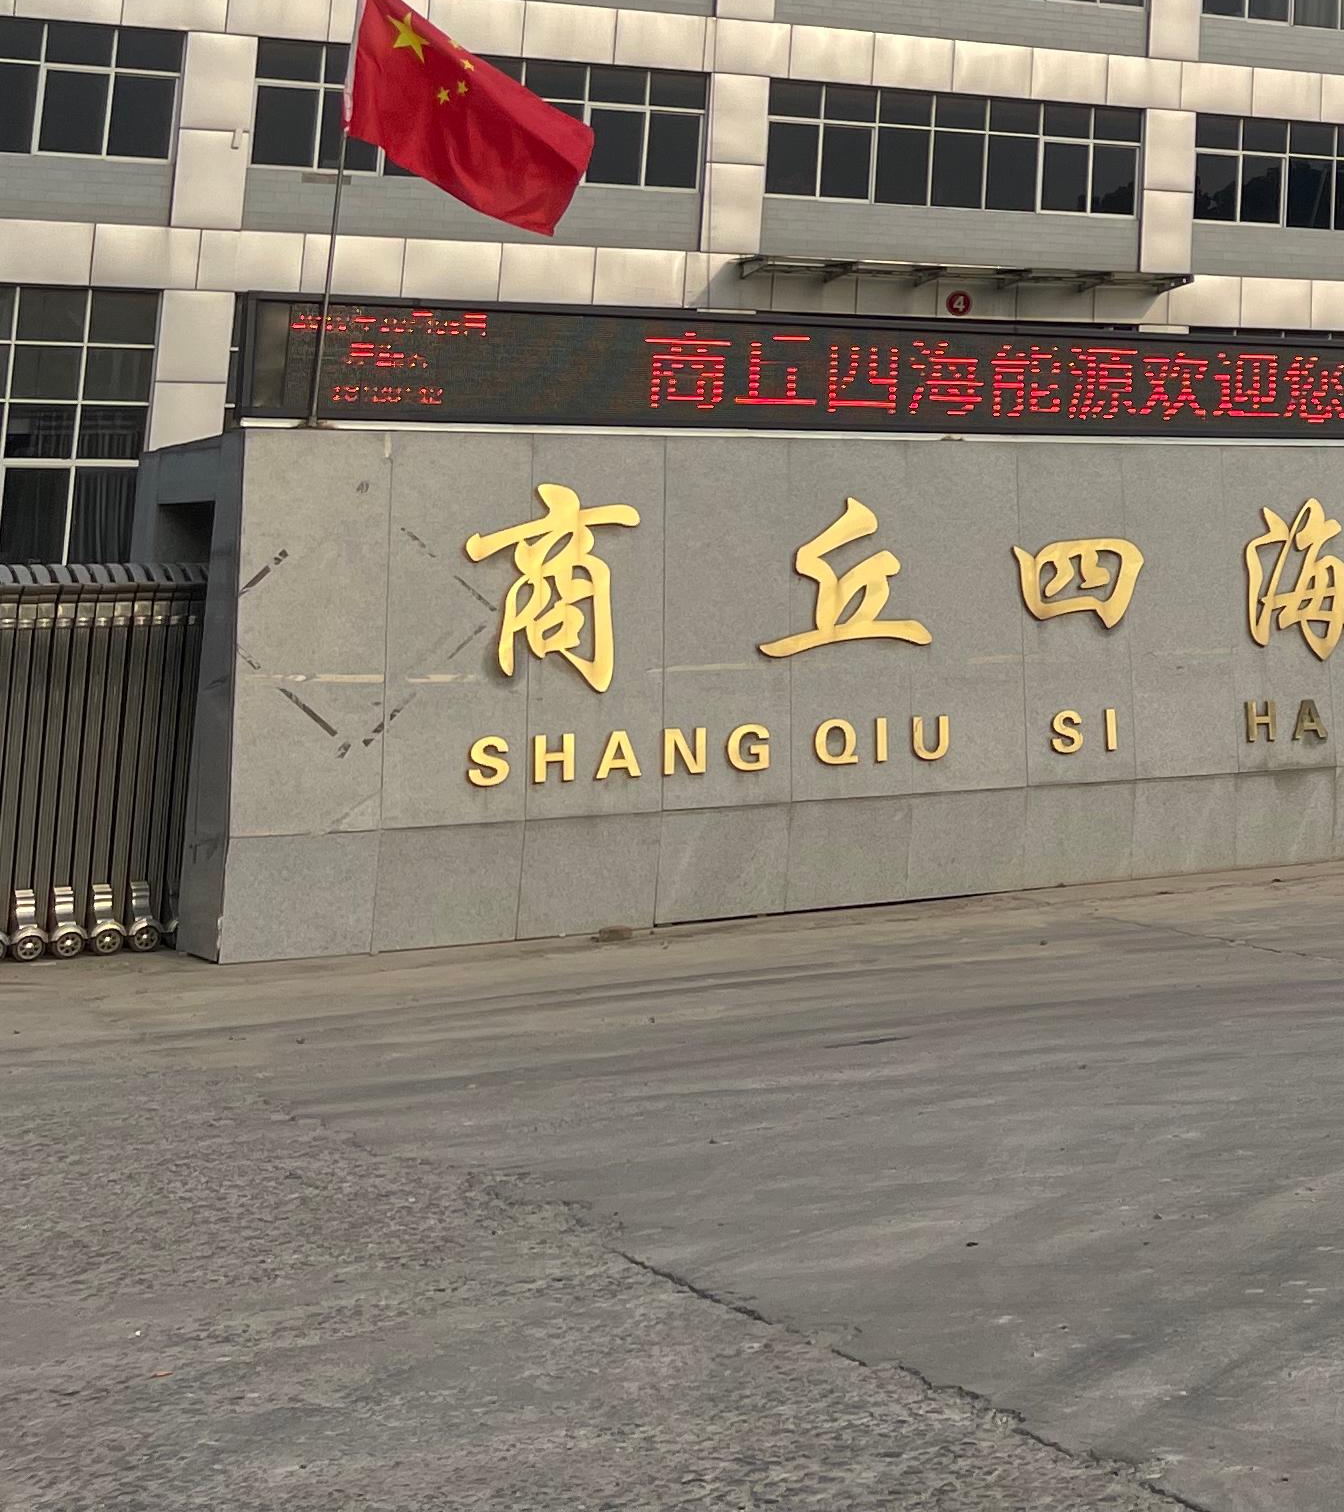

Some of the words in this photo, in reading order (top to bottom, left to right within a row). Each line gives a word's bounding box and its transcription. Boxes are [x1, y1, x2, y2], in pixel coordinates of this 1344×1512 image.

[952, 295, 966, 312] 4
[467, 724, 771, 787] SHANG
[814, 715, 951, 766] QIU
[1050, 708, 1119, 755] SI
